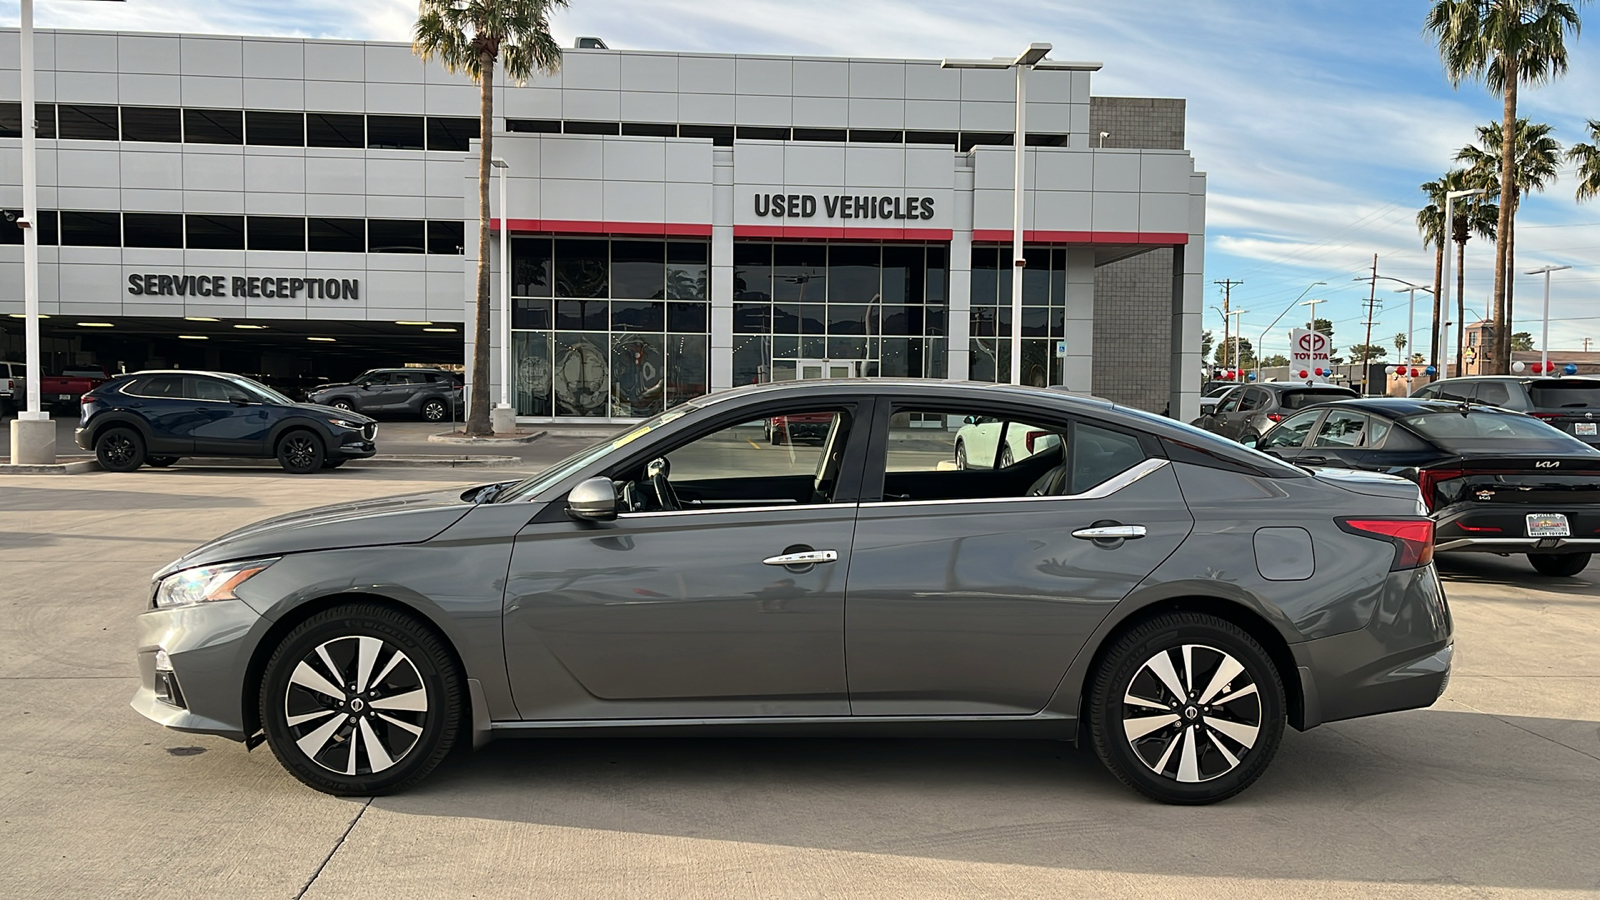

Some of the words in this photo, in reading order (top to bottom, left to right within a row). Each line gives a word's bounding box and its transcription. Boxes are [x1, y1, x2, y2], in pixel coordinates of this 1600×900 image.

[754, 194, 817, 218] USED
[823, 195, 935, 220] VEHICLES
[128, 273, 227, 297] SERVICE
[231, 276, 359, 300] RECEPTION
[1294, 352, 1329, 360] TOYOTA
